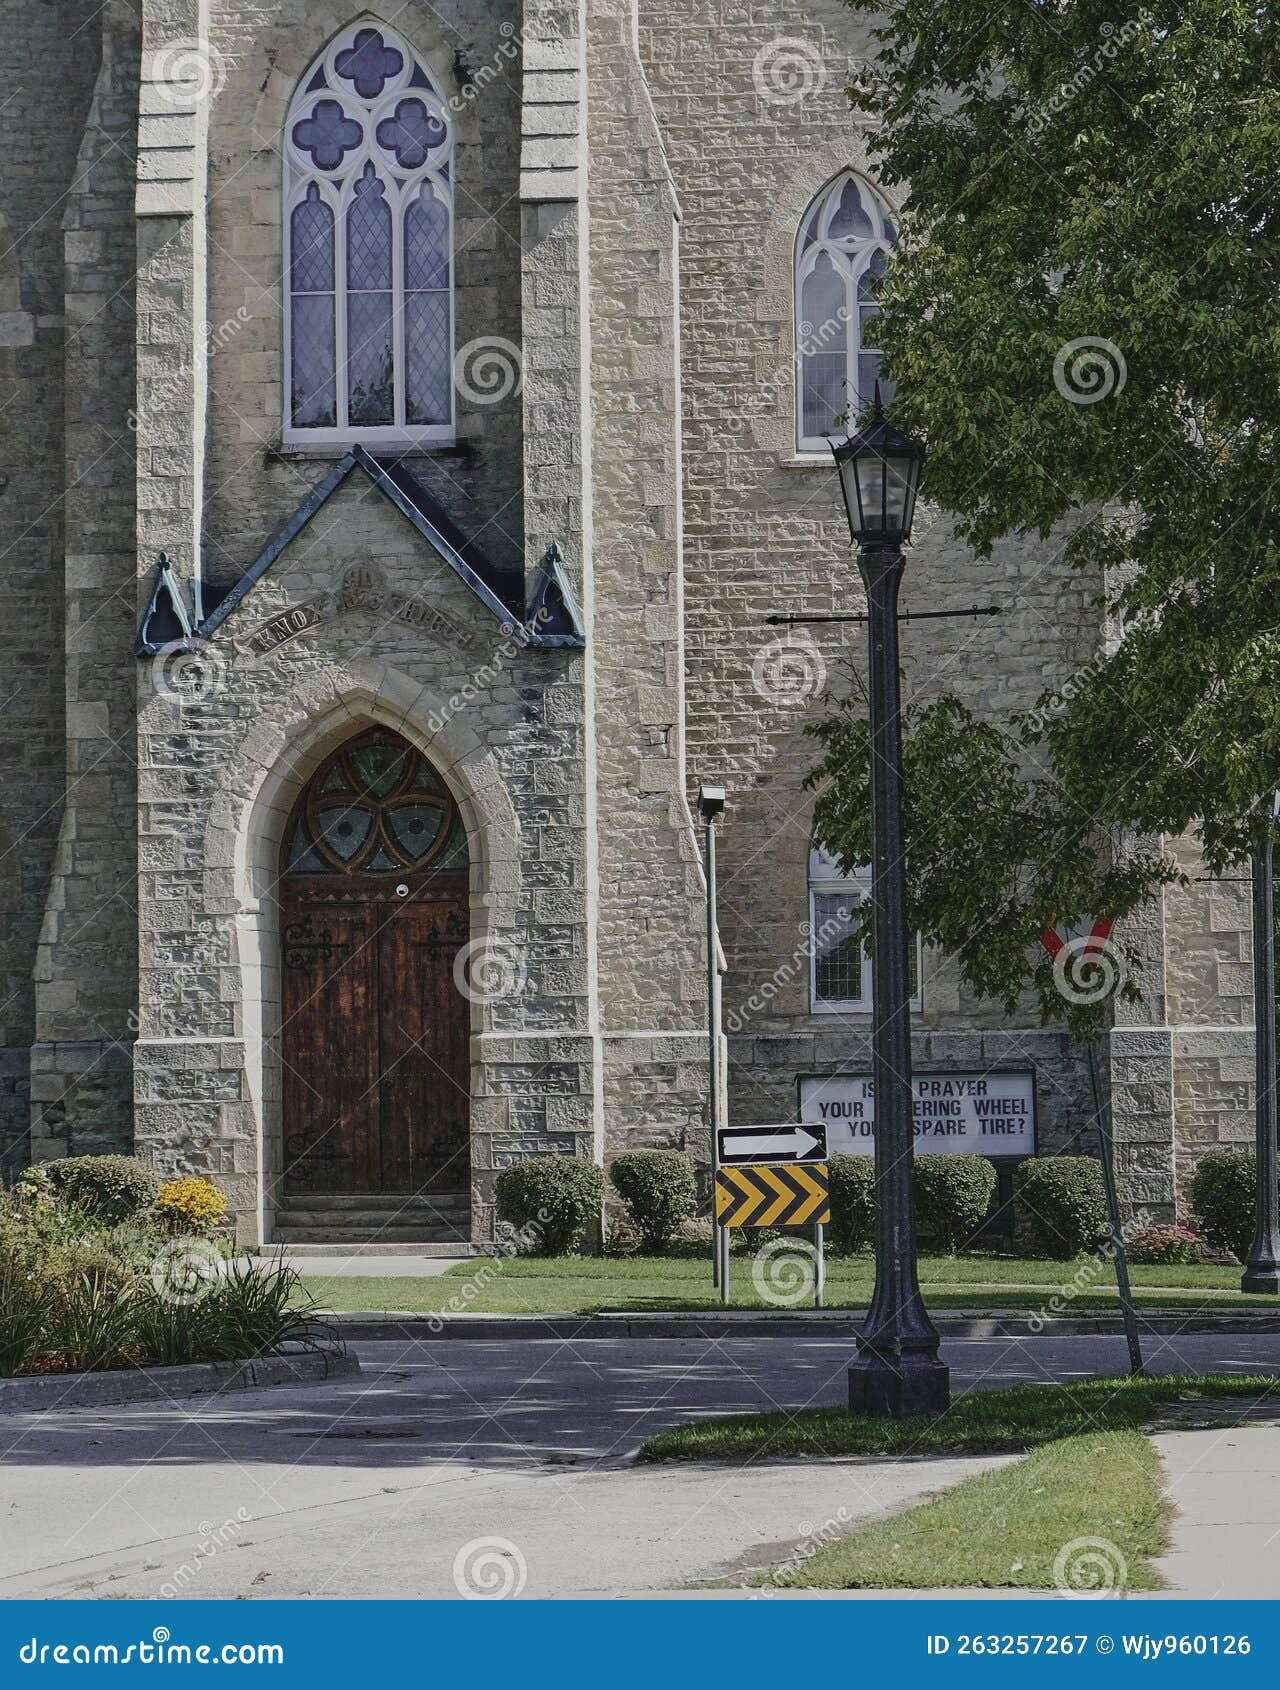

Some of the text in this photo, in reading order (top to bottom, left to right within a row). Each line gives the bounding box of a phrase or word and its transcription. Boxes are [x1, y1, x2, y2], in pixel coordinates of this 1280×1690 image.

[919, 1080, 988, 1097] PRAYER
[819, 1099, 1029, 1118] YOUR ERING WHEEL
[912, 1119, 967, 1136] SPARE
[978, 1118, 1025, 1135] TIRE?
